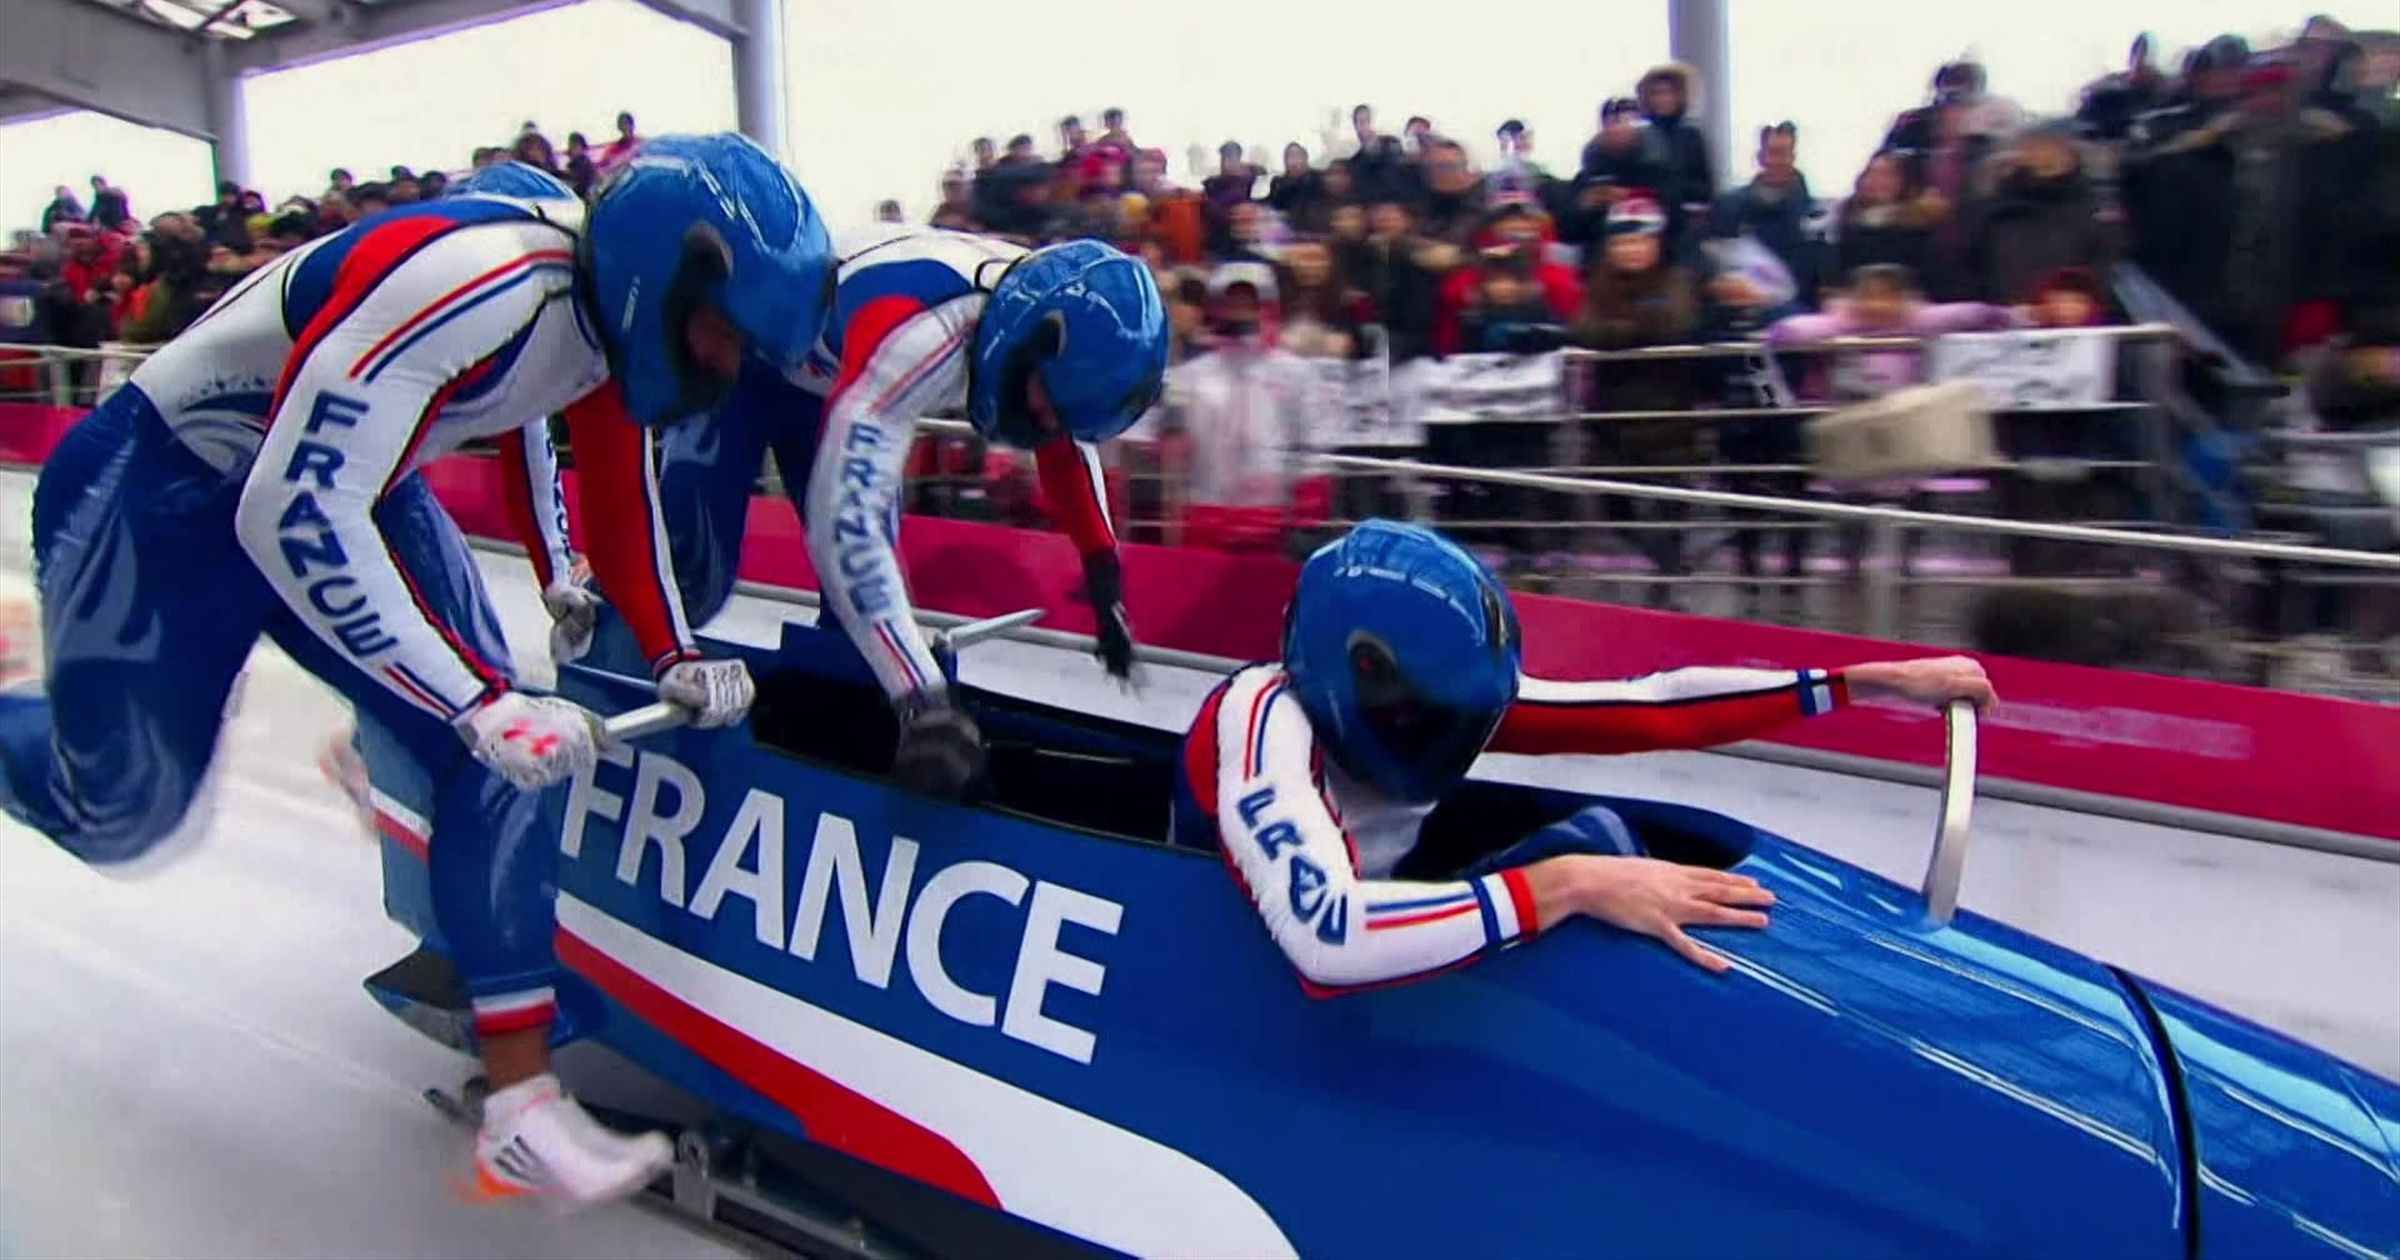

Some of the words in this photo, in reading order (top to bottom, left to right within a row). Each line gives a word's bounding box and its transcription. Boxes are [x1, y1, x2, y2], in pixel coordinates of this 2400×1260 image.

[279, 389, 399, 658] FRANCE
[835, 422, 892, 615] FRANCE
[560, 741, 1124, 1066] FRANCE
